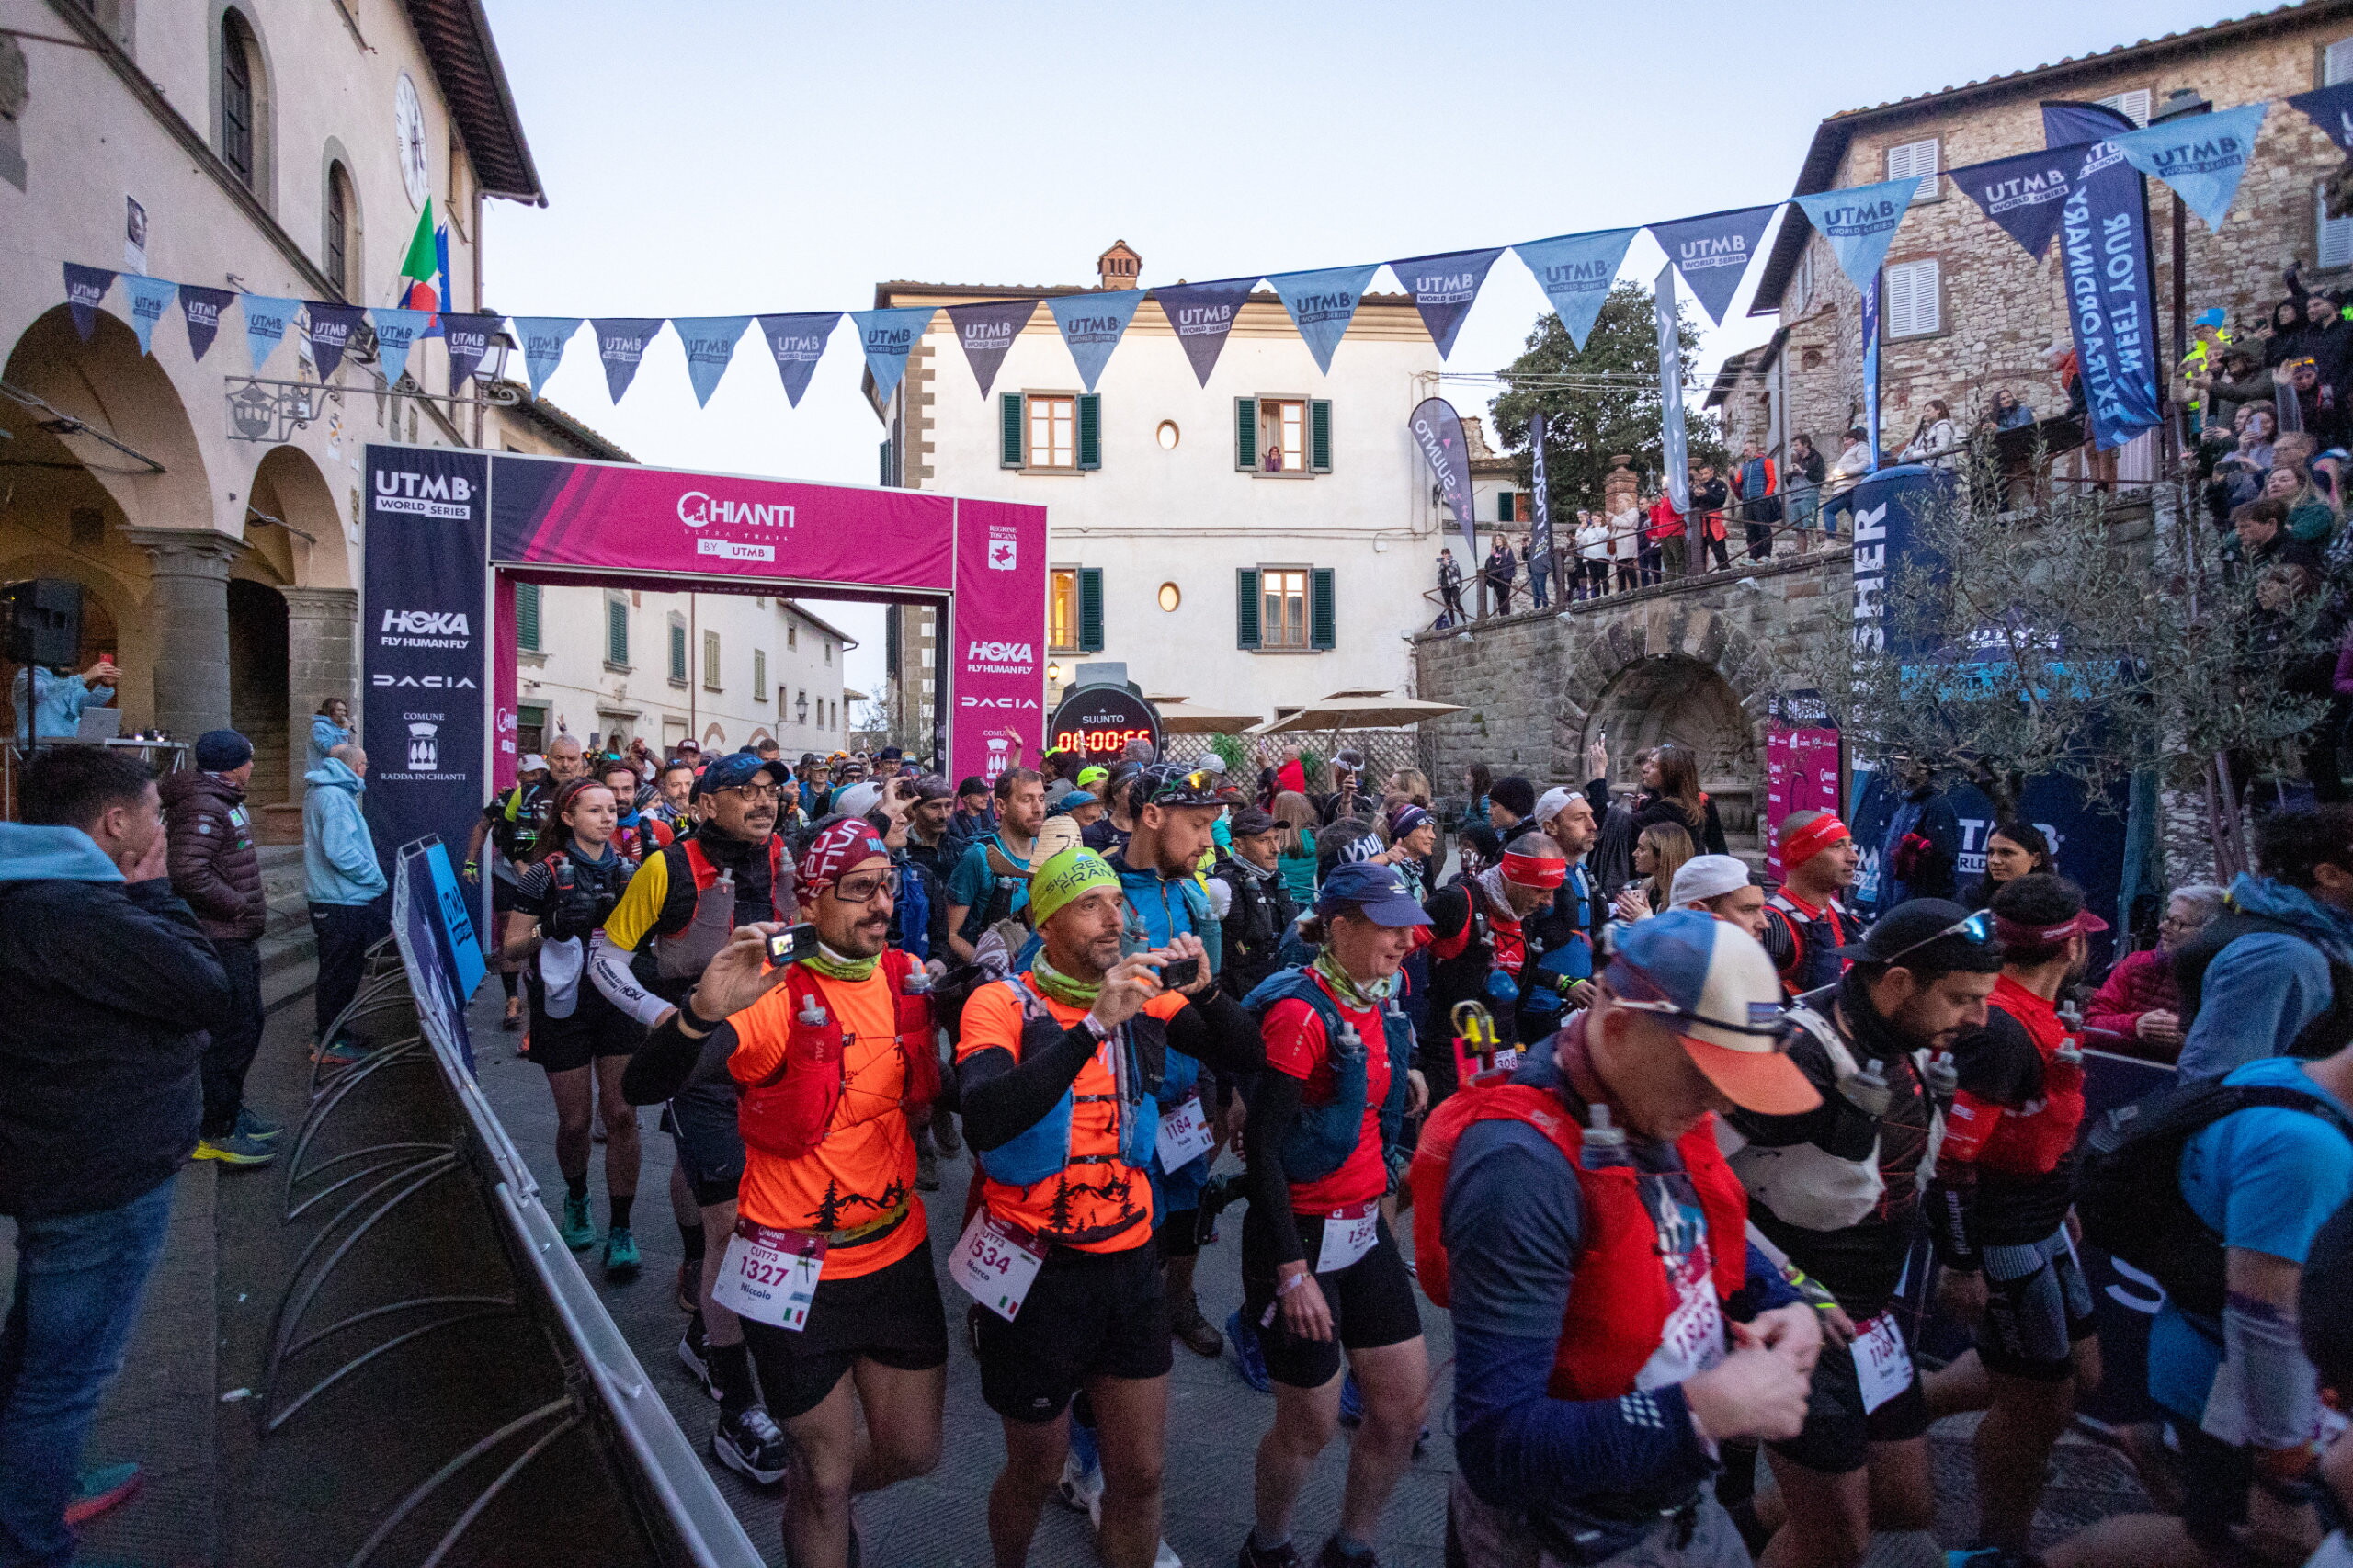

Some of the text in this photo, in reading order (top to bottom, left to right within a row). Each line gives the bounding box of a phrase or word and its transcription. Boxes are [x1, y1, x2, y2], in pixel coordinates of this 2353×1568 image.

[2152, 135, 2239, 168] UTMB
[2163, 160, 2201, 177] WORLD
[1985, 169, 2065, 203] UTMB
[1993, 185, 2067, 214] WORLD SERIES
[1824, 200, 1894, 226] UTMB
[1830, 221, 1894, 237] WORLD SERIES
[1680, 234, 1746, 259] UTMB
[1684, 254, 1745, 269] WORLD SERIES
[1546, 260, 1608, 283] UTMB
[1416, 274, 1473, 293] UTMB
[1550, 279, 1607, 293] WORLD SERIES
[134, 296, 162, 311] UTMB
[1297, 292, 1351, 314] UTMB
[1420, 292, 1472, 303] WORLD SERIES
[251, 314, 282, 329] UTMB
[1179, 304, 1231, 325] UTMB
[1301, 311, 1349, 323] WORLD SERIES
[315, 323, 347, 336] UTMB
[381, 325, 413, 339] UTMB
[965, 323, 1011, 339] UTMB
[1068, 317, 1119, 334] UTMB
[1182, 323, 1230, 335] WORLD SERIES
[452, 333, 485, 347] UTMB
[529, 336, 560, 351] UTMB
[605, 337, 642, 351] UTMB
[778, 335, 819, 351] UTMB
[868, 329, 911, 344] UTMB
[967, 339, 1009, 348] WORLD SERIES
[1070, 335, 1117, 344] WORLD SERIES
[689, 339, 729, 353] UTMB
[376, 470, 472, 502] UTMB
[381, 499, 467, 517] WORLD SERIES
[677, 491, 795, 528] CHIANTI
[684, 528, 789, 541] ULTRA TRAIL
[989, 525, 1017, 533] REGIONE
[704, 542, 765, 558] BY UTMB
[381, 609, 469, 635] HOKA
[381, 637, 469, 649] FLY HUMAN FLY
[968, 641, 1033, 663] HOKA
[983, 665, 1017, 674] HUMAN
[1017, 666, 1032, 675] FLY
[373, 675, 477, 688] DACIA
[961, 697, 1039, 709] DACIA
[403, 712, 445, 721] COMUNE
[1083, 715, 1124, 723] SUUNTO
[381, 772, 414, 780] RADDA
[427, 773, 466, 781] CHIANTI
[1046, 872, 1068, 894] SKI
[1165, 1116, 1192, 1140] 1184
[750, 1246, 779, 1262] CUT73
[969, 1233, 1012, 1275] 1534
[740, 1256, 790, 1287] 1327
[967, 1259, 990, 1281] Marco
[740, 1282, 771, 1301] Niccolo
